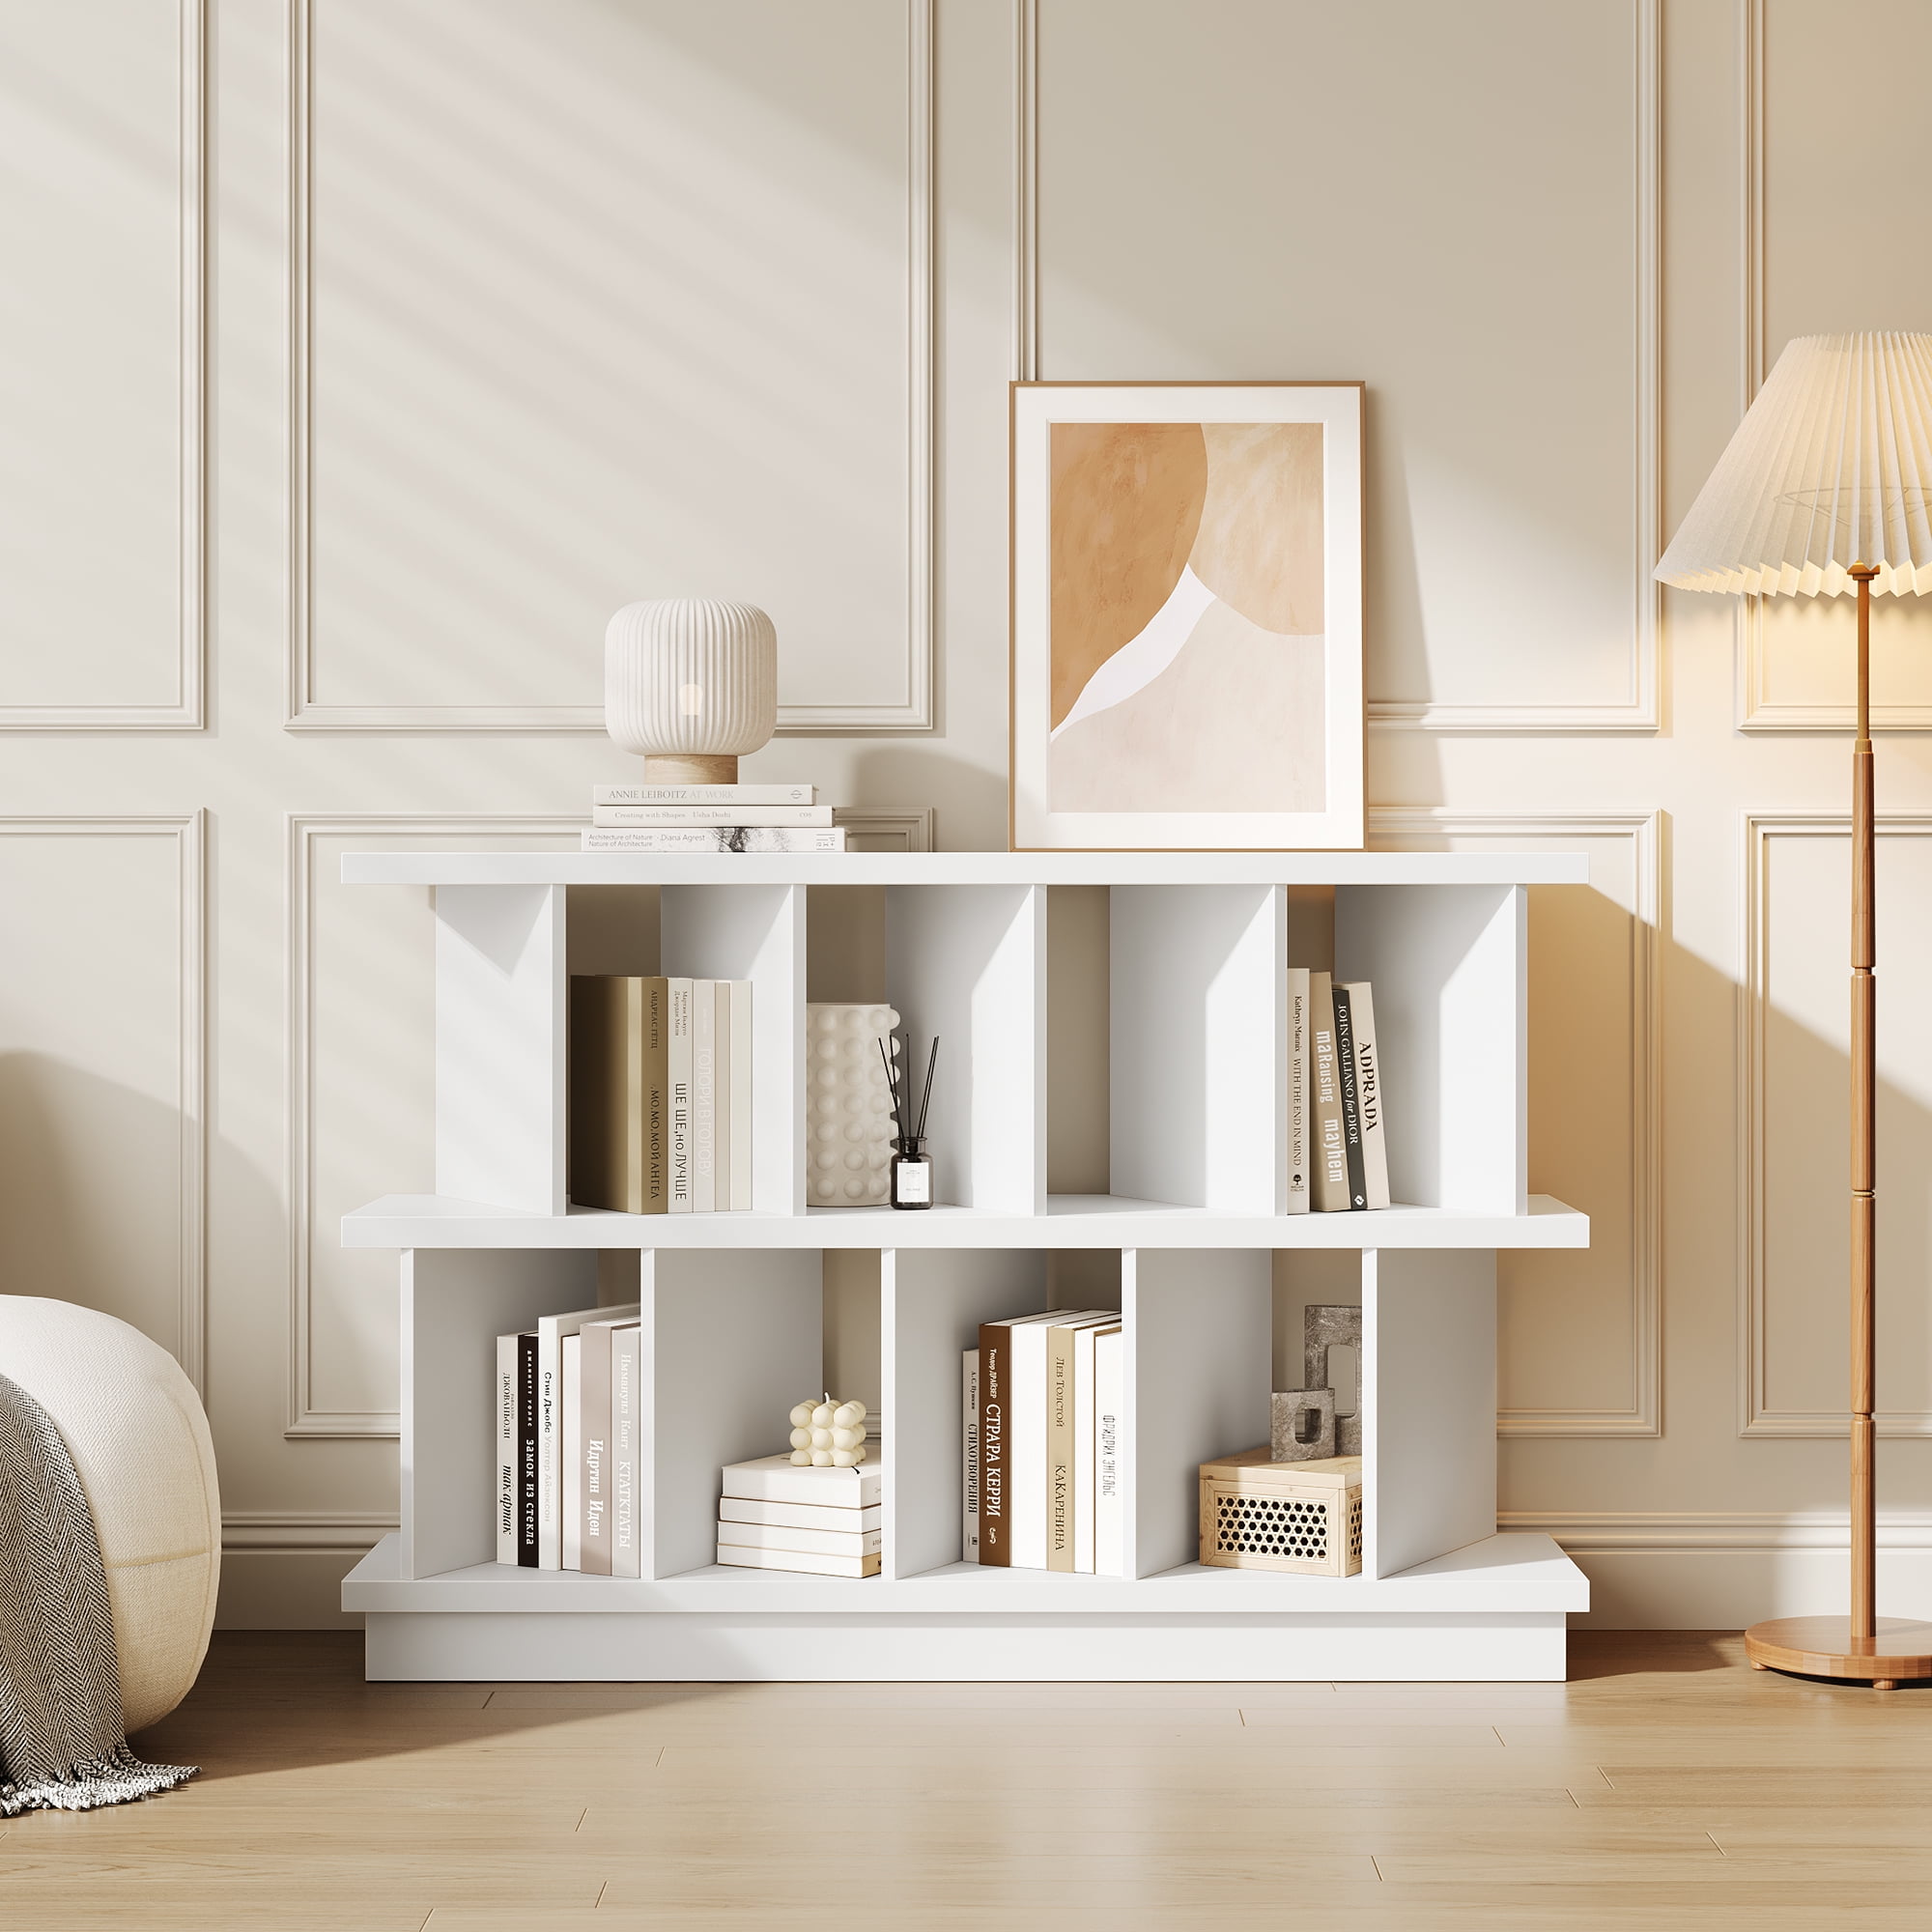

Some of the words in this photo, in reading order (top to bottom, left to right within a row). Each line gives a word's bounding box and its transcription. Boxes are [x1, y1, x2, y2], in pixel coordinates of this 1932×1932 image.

[609, 790, 639, 799] ANNIE
[689, 790, 701, 799] AT
[706, 790, 734, 799] WORK
[682, 834, 705, 842] Agrest
[1293, 996, 1302, 1024] Kathryn
[1338, 1005, 1349, 1036] JOHN
[1341, 1037, 1354, 1097] GALLIANO
[675, 1083, 687, 1104] ШЕ
[1359, 1042, 1377, 1131] ADPRADA
[1345, 1099, 1355, 1113] for
[1293, 1127, 1301, 1138] IN
[1348, 1115, 1358, 1144] DIOR
[1322, 1120, 1345, 1182] mayhem
[650, 1162, 661, 1199] АНГЕЛ
[675, 1153, 687, 1200] ЛУЧШЕ
[988, 1348, 997, 1370] Теодор
[618, 1353, 632, 1414] Иммануил
[989, 1370, 998, 1399] ДРАЙЗЕР
[543, 1399, 553, 1433] Джобс
[620, 1419, 632, 1449] Кант
[1101, 1414, 1116, 1456] ФРИДРИХ
[526, 1438, 534, 1478] замок
[586, 1438, 604, 1493] Идртин
[968, 1423, 979, 1514] СТИХОТВОРЕНИЯ
[502, 1464, 512, 1492] так
[526, 1483, 534, 1498] из
[985, 1467, 1001, 1518] КЕРРИ
[1101, 1459, 1116, 1496] ЭНГЕЛЬС
[499, 1493, 513, 1535] артак
[586, 1499, 604, 1537] Иден
[618, 1461, 631, 1548] КТАТКТАТЫ
[526, 1502, 534, 1546] стекла
